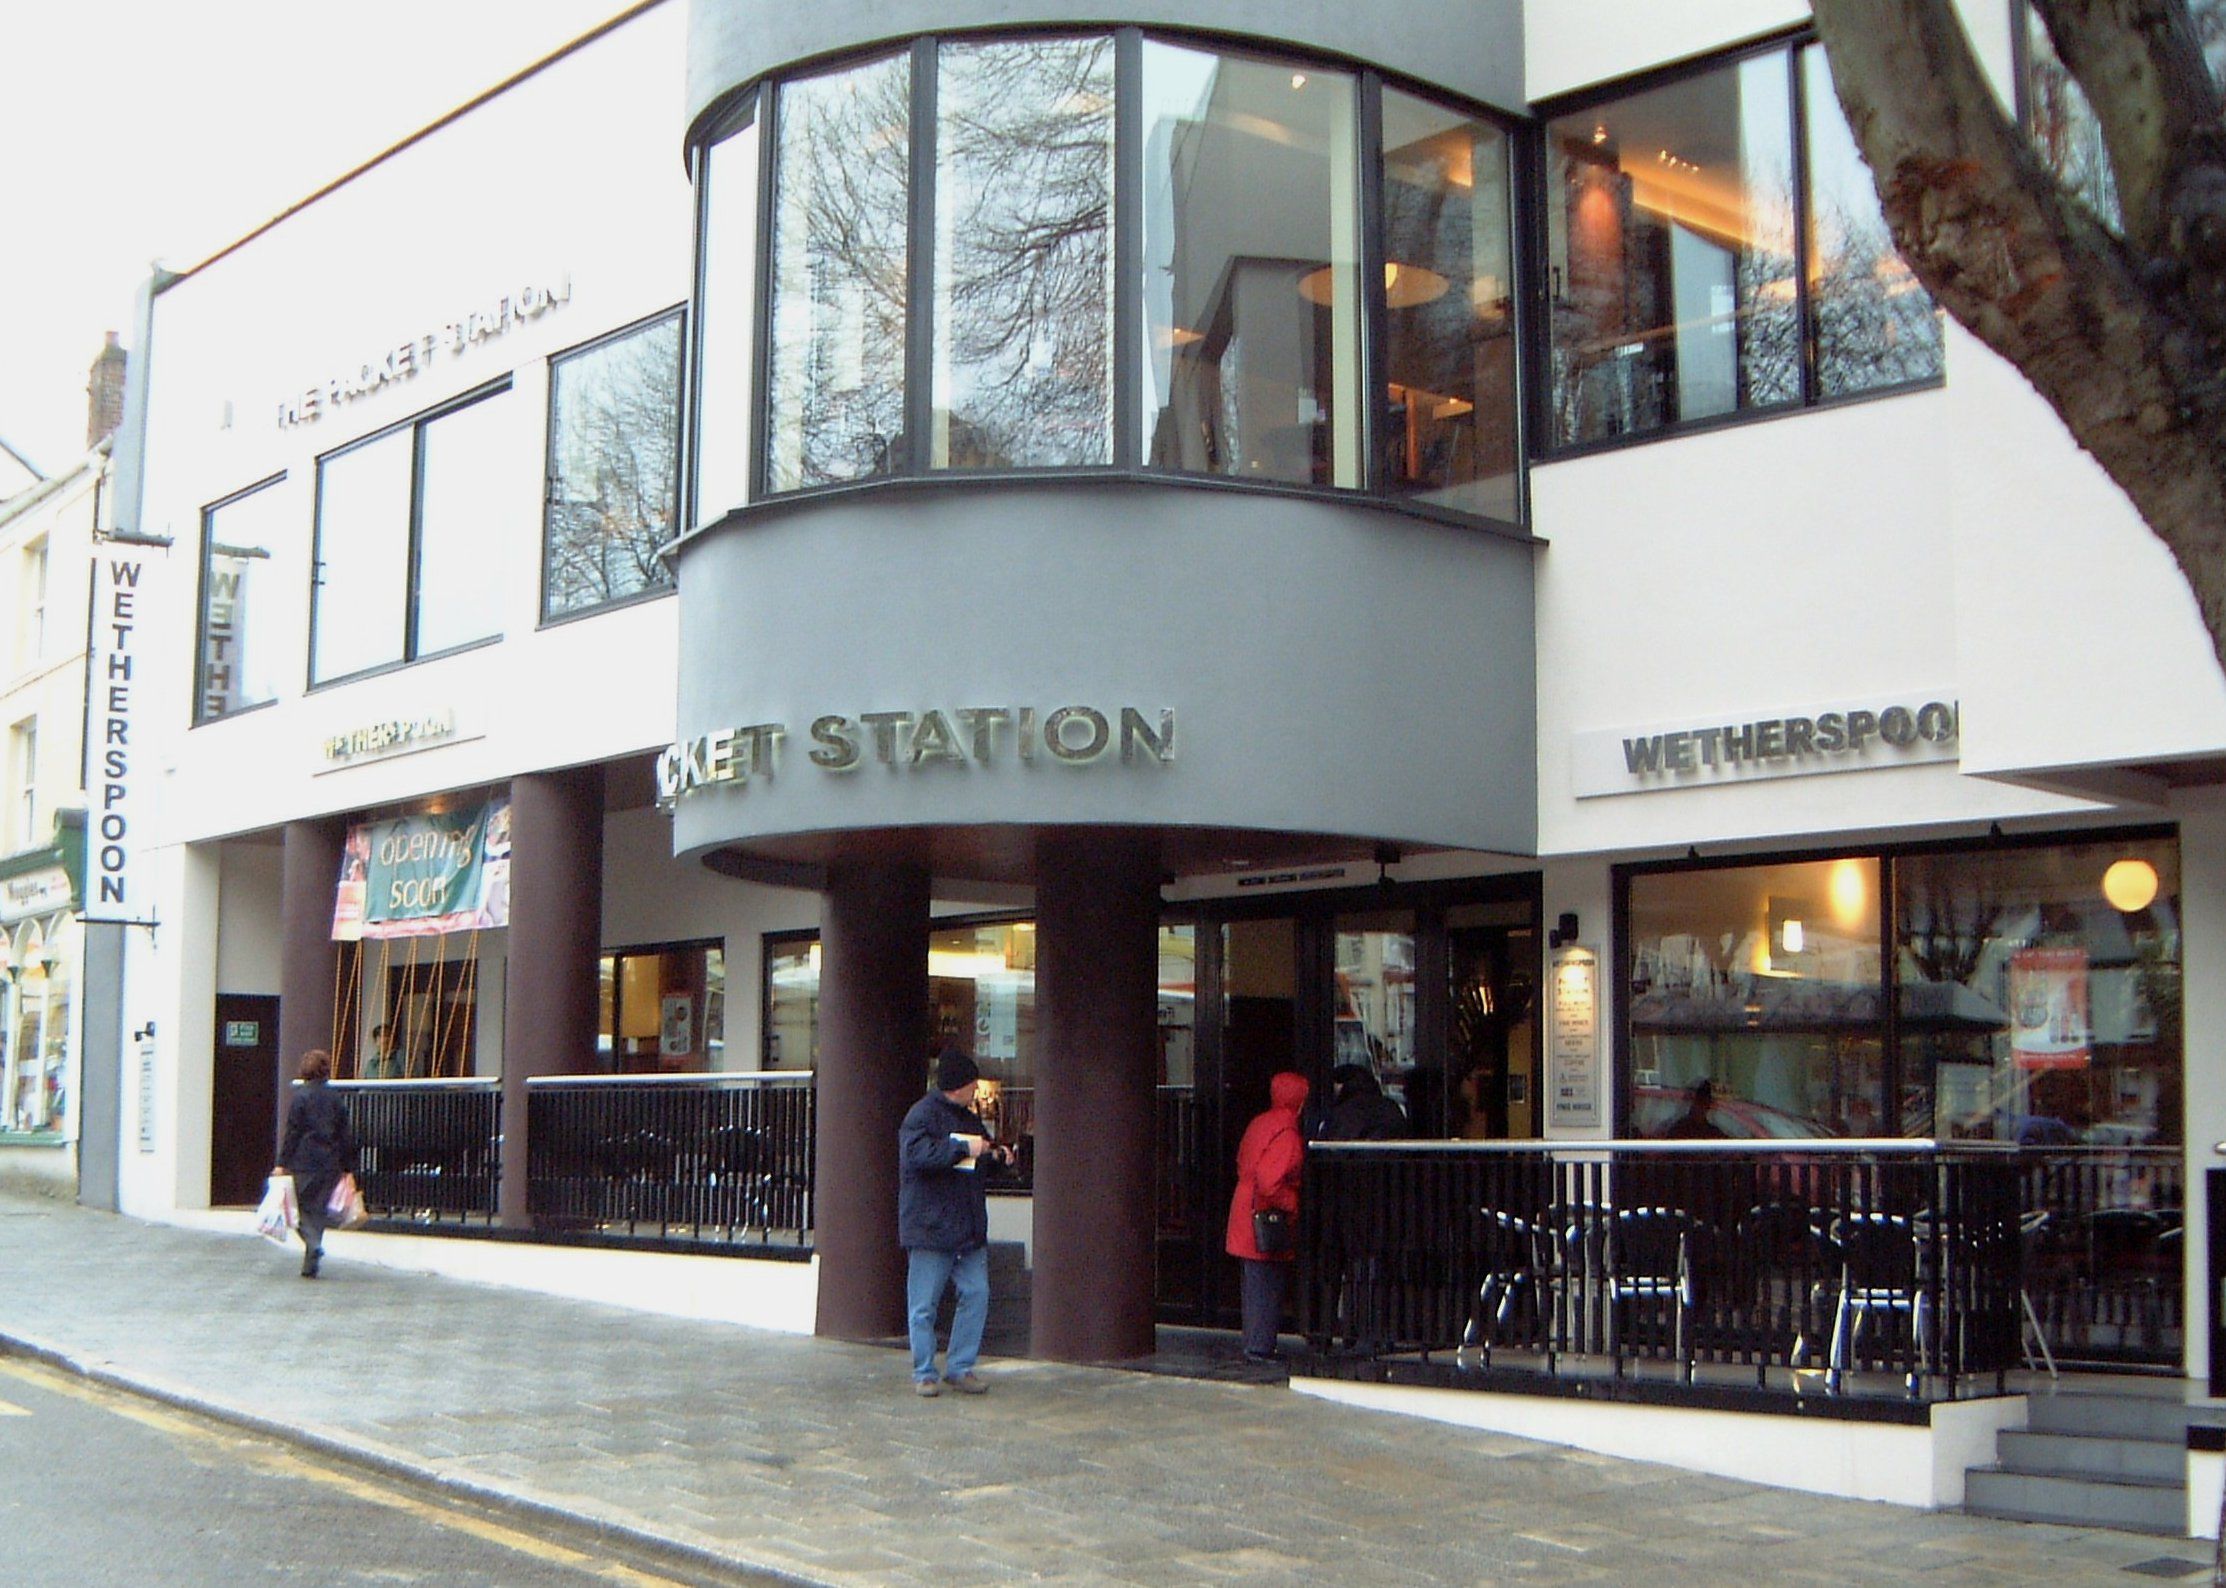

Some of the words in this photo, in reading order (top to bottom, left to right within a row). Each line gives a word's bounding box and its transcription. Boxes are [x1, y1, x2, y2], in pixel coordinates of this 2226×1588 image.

[100, 560, 142, 904] WETHERSPOON
[808, 706, 1176, 772] STATION
[1622, 699, 1960, 776] WETHERSPOO
